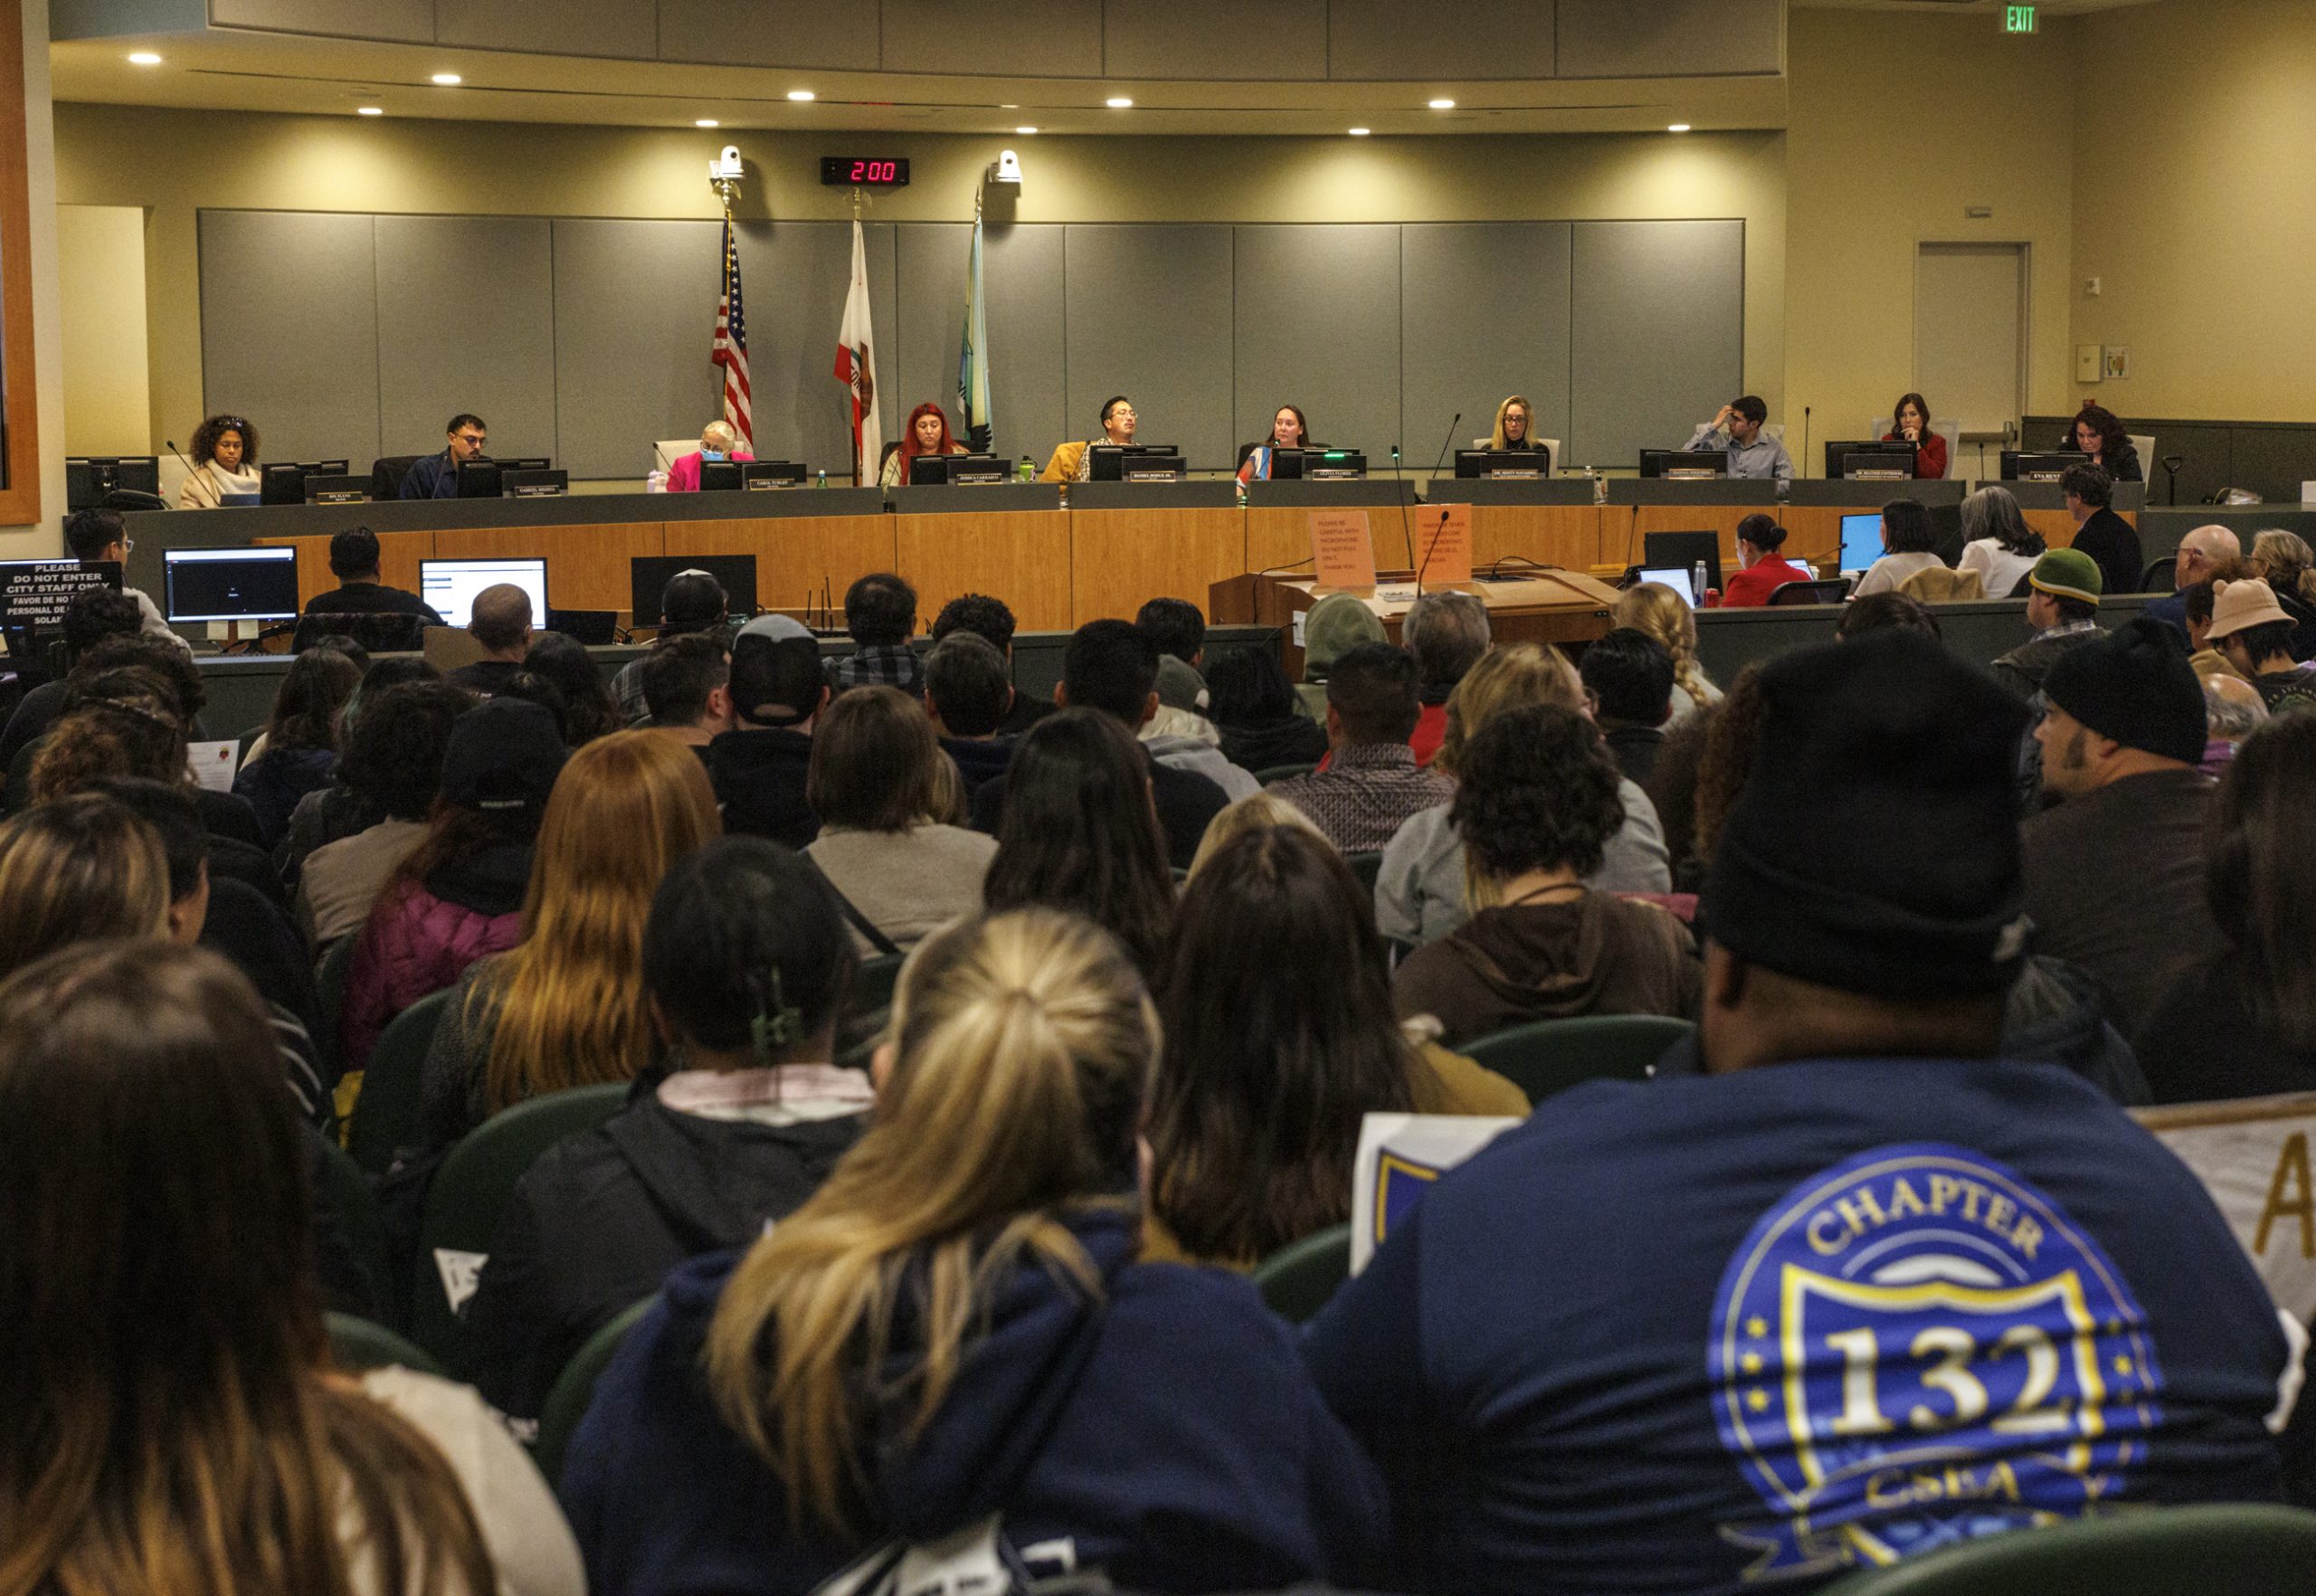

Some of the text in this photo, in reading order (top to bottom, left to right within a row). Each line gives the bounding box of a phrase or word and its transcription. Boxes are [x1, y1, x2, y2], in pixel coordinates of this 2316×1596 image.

[2007, 6, 2035, 32] EXIT
[35, 563, 81, 573] PLEASE
[14, 573, 102, 584] DO NOT ENTER
[6, 583, 110, 594] CITY STAFF ONY
[13, 597, 41, 605] FAVOR
[43, 596, 54, 604] DE
[56, 595, 69, 603] NO
[7, 607, 52, 615] PERSONAL
[2253, 1132, 2316, 1259] A
[1808, 1174, 2046, 1261] CHAPTER
[1825, 1325, 2073, 1435] 132
